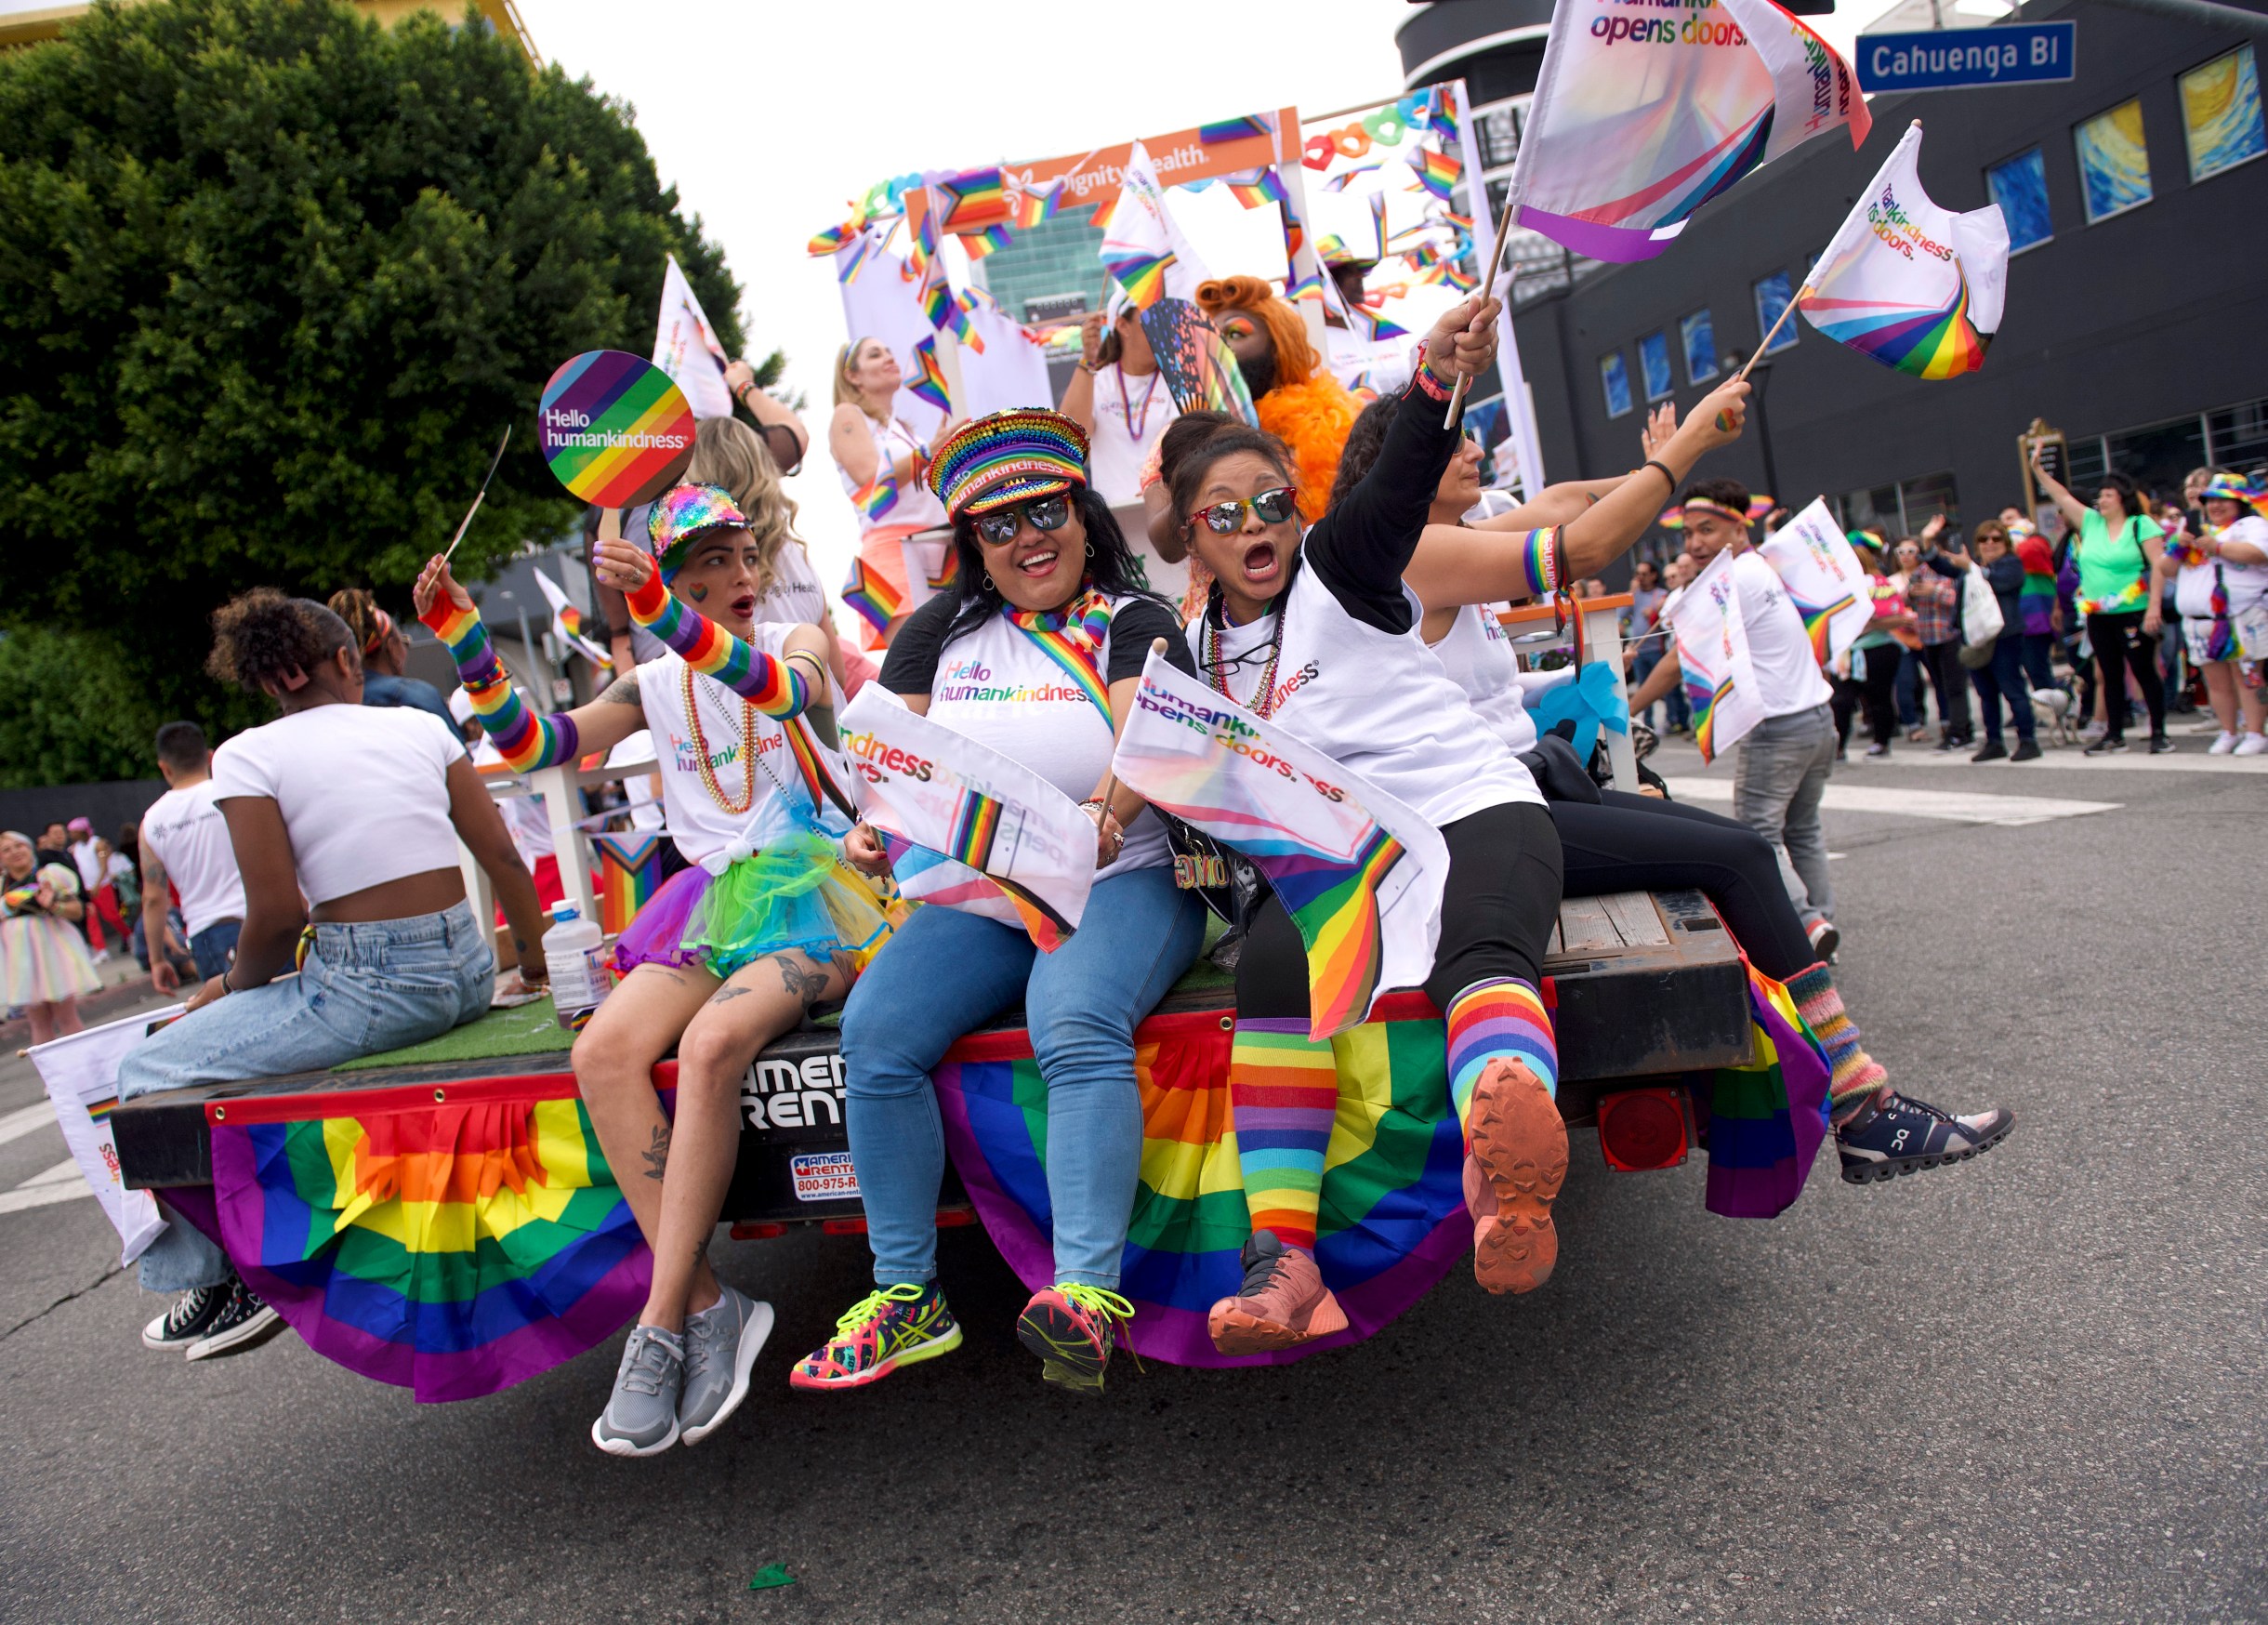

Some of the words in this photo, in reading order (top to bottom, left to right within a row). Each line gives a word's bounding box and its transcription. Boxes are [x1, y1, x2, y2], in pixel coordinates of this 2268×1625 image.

[1591, 16, 1676, 46] opens
[1872, 44, 2018, 78] Cahuenga
[2030, 35, 2058, 66] Bl
[1151, 143, 1207, 174] ealth
[1873, 218, 1915, 260] doors.
[546, 409, 590, 428] Hello
[944, 469, 971, 499] Hello
[950, 458, 1064, 512] humankindness
[944, 660, 991, 681] Hello
[940, 683, 1094, 704] humankindnes
[1215, 733, 1298, 784] doors.
[741, 1088, 846, 1130] REN
